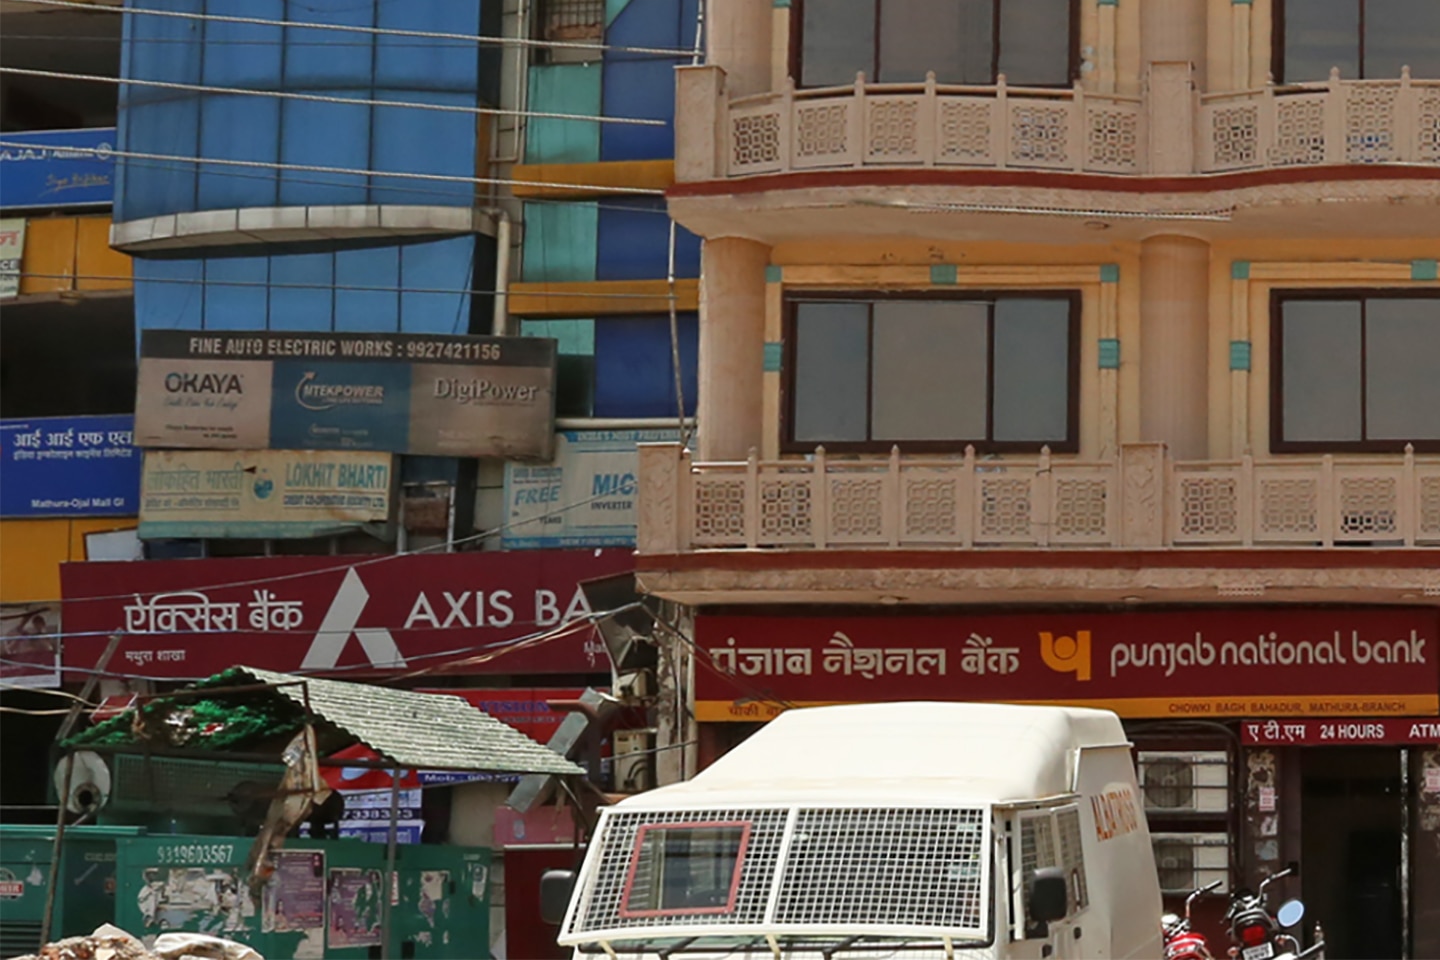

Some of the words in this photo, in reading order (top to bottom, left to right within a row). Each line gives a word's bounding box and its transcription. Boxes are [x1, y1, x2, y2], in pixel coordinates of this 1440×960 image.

[189, 337, 222, 354] FINE
[225, 338, 263, 355] AUTO
[267, 339, 336, 356] ELECTRIC
[340, 340, 393, 357] WORKS
[406, 341, 501, 360] 9927421156
[164, 372, 243, 395] OKAYA
[433, 377, 538, 405] DigiPower
[13, 428, 42, 448] आई
[45, 428, 74, 448] आई
[78, 431, 104, 446] एफ
[285, 462, 336, 487] LOKHIT
[337, 463, 388, 489] BHARTI
[591, 473, 638, 496] MIC
[514, 484, 562, 507] FREE
[123, 591, 241, 633] ऐक्सिस
[247, 589, 304, 632] बैंक
[403, 589, 514, 630] AXIS
[156, 649, 186, 662] शाखा
[708, 637, 812, 676] पंजाब
[822, 631, 946, 679] नैशनल
[960, 632, 1020, 675] बैंक
[1110, 632, 1216, 677] punjab
[1220, 630, 1346, 666] national
[1352, 630, 1426, 665] bank
[1168, 703, 1211, 714] CHOWKI
[1215, 703, 1246, 713] BAGH
[1309, 701, 1406, 713] MATHURA-BRANCH
[1320, 724, 1337, 739] 24
[1338, 724, 1385, 739] HOURS
